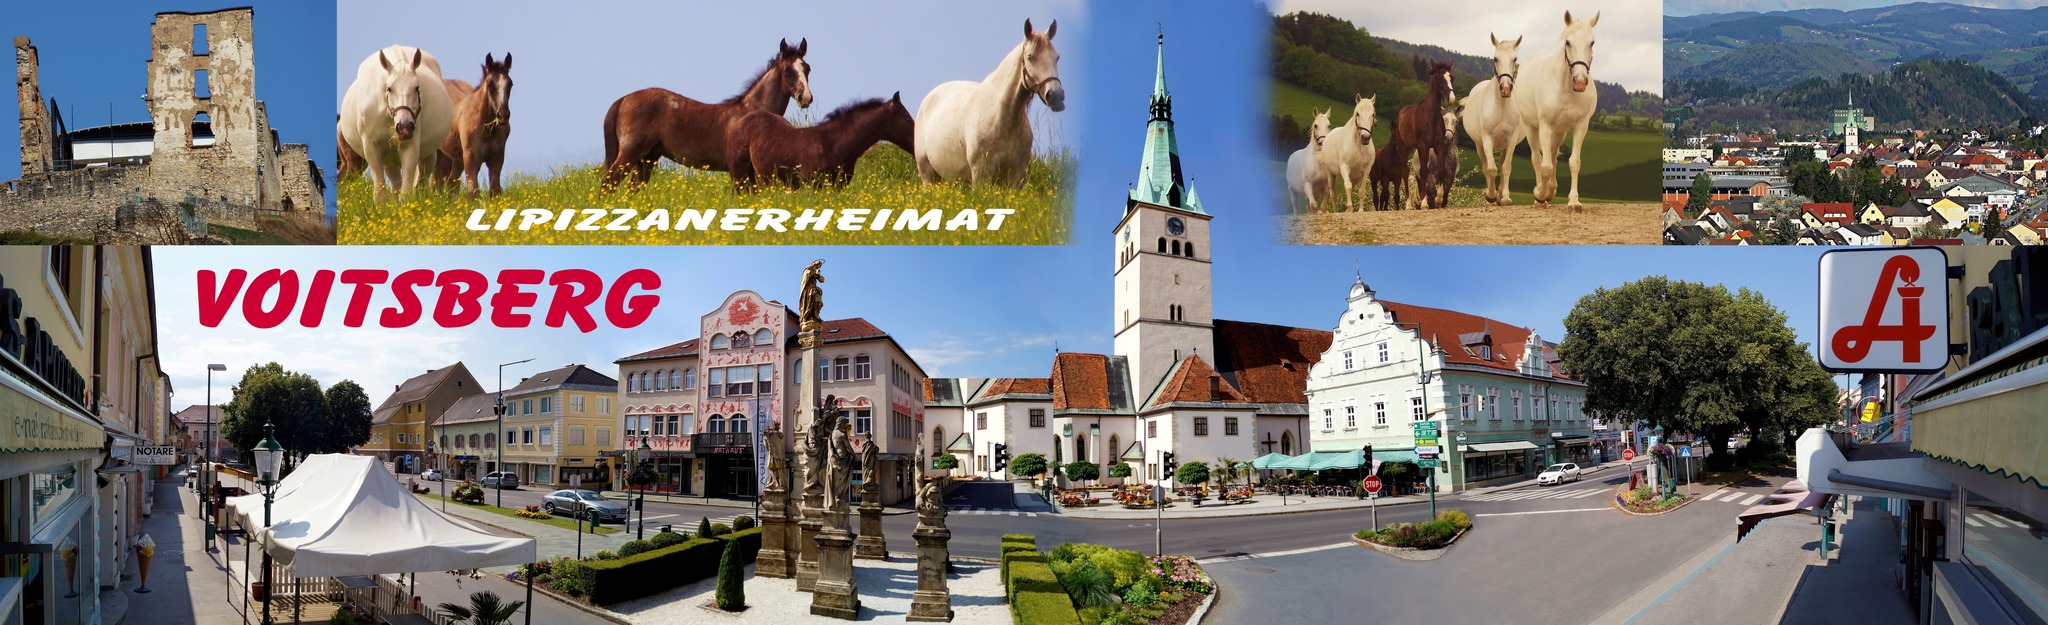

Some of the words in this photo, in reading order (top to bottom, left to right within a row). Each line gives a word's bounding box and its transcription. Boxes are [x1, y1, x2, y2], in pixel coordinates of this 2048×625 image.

[136, 447, 174, 456] NOTARE
[713, 446, 746, 454] RATHAUS
[405, 454, 412, 462] P
[1365, 480, 1380, 488] STOP
